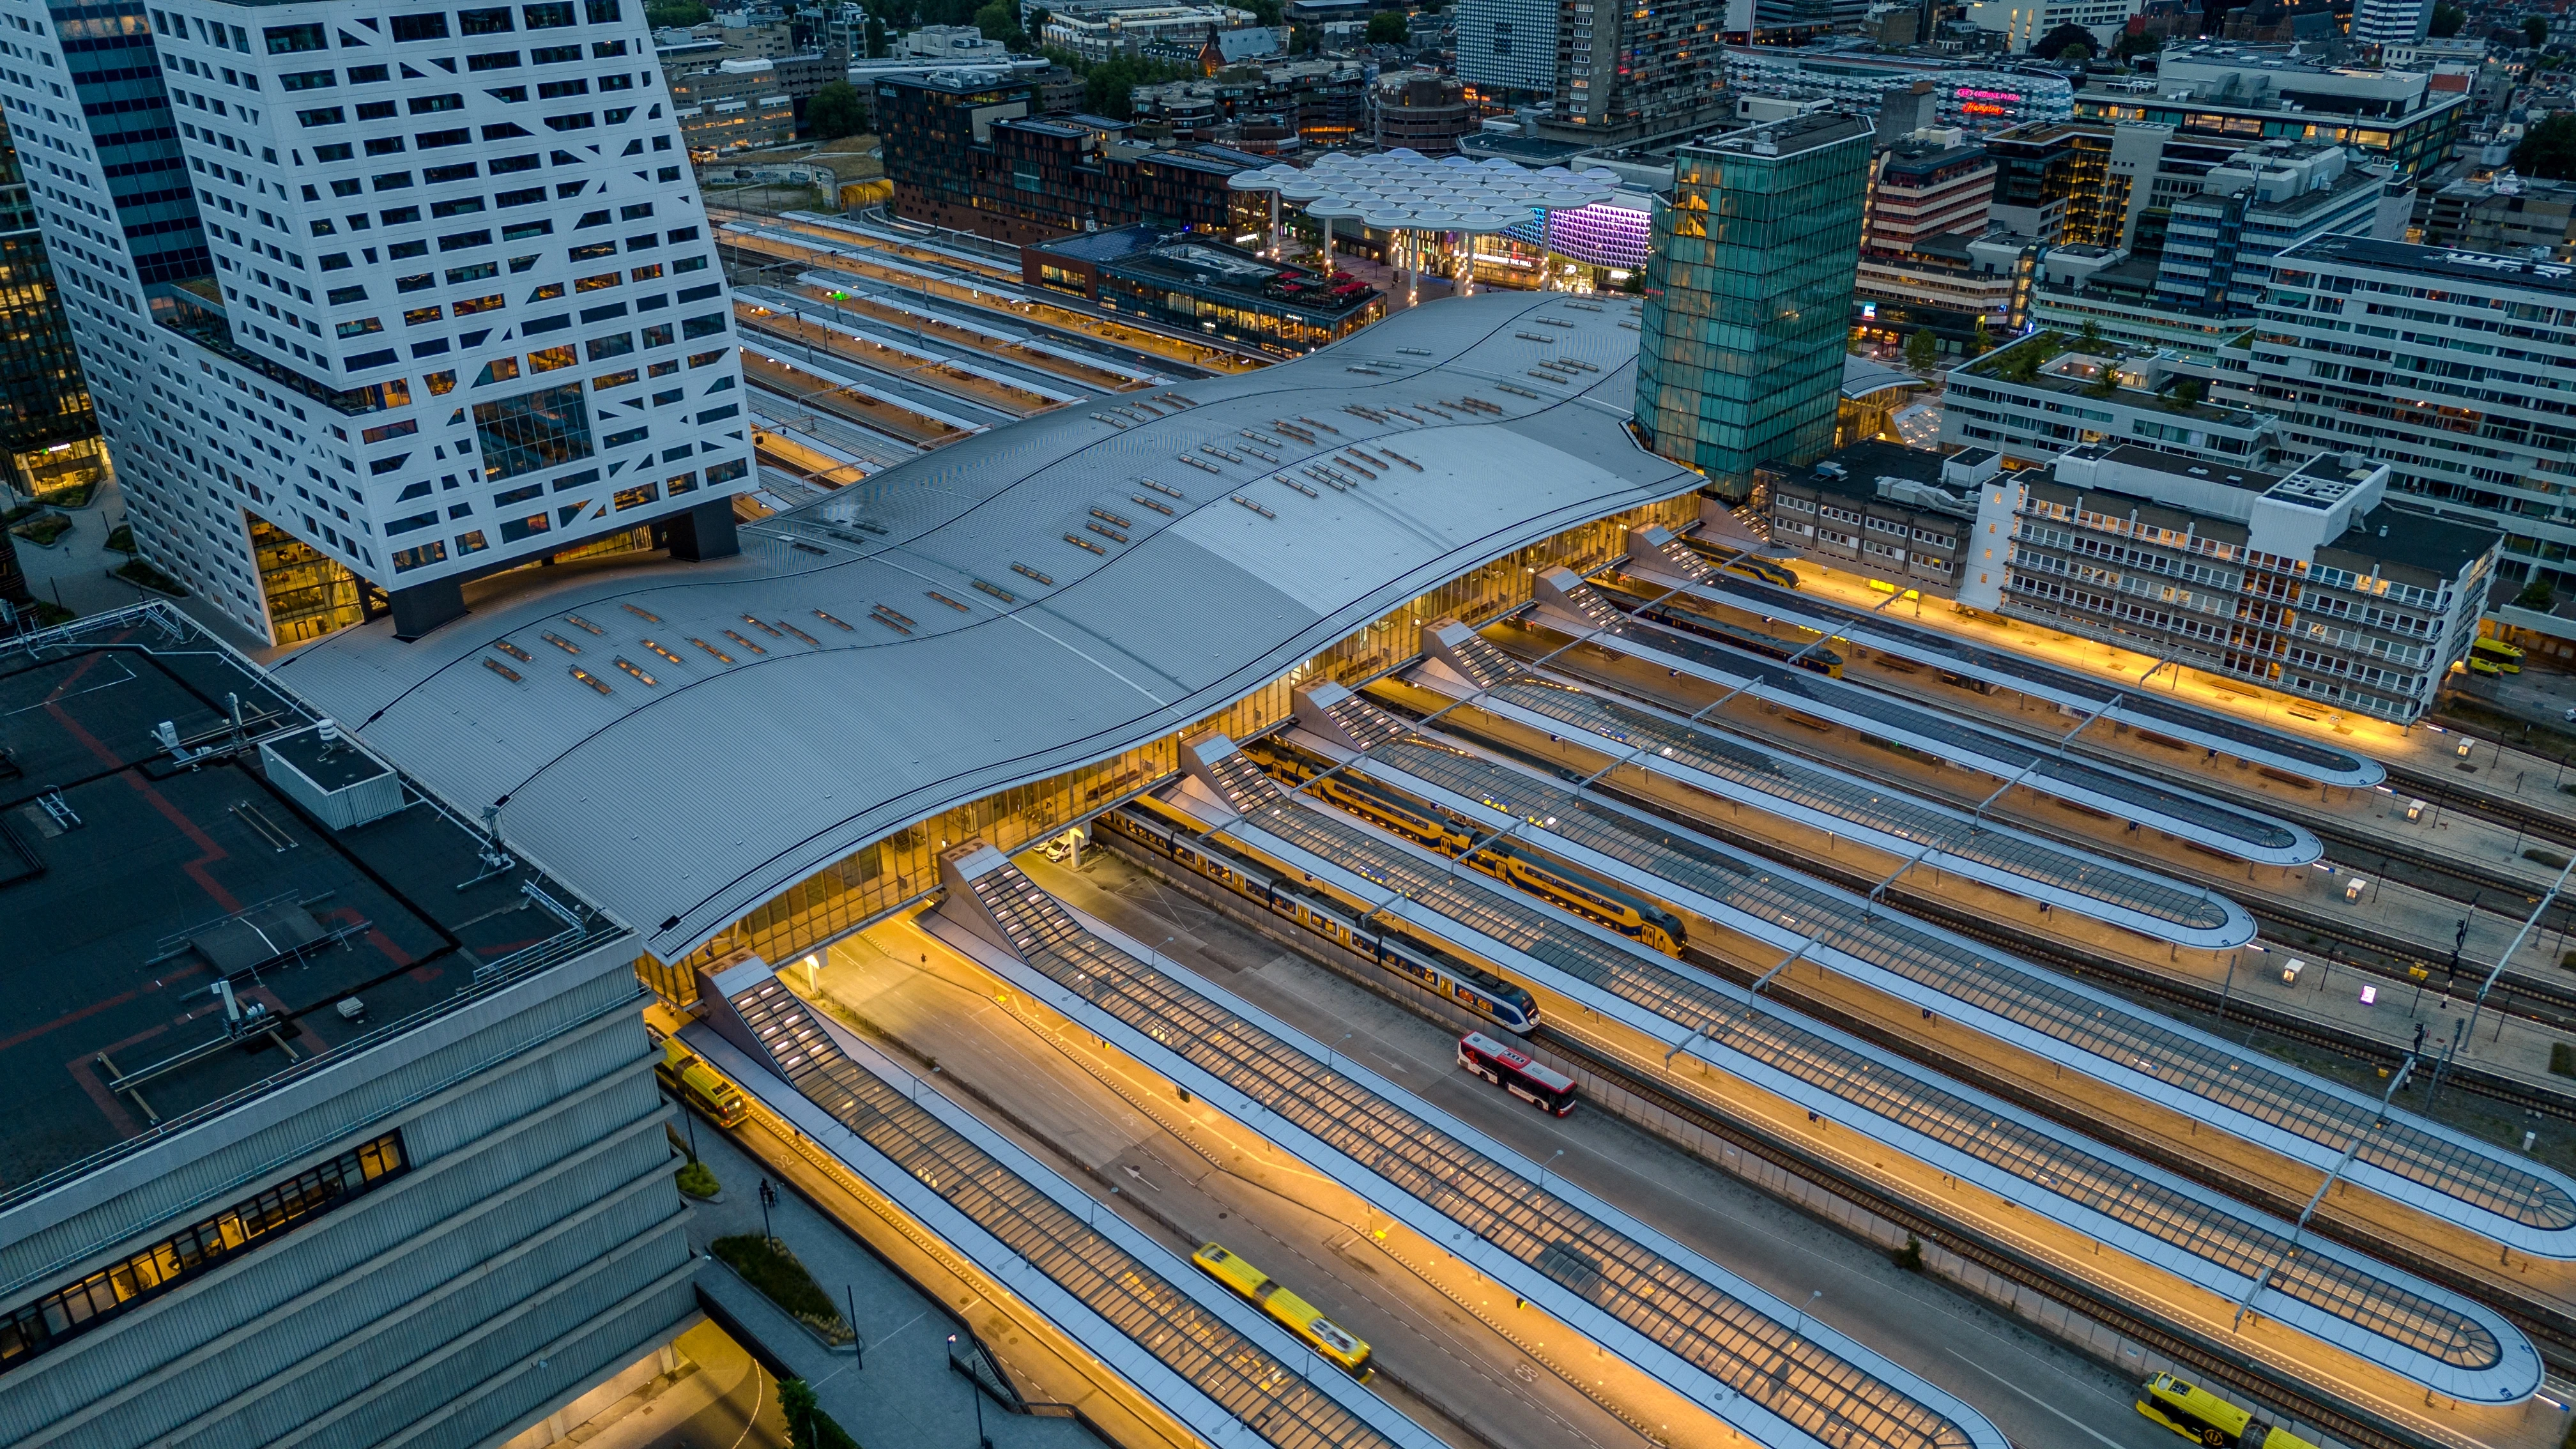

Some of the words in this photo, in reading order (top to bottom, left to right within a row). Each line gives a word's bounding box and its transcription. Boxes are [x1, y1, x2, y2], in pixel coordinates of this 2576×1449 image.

[1974, 91, 1999, 99] CROWNE
[2000, 93, 2020, 101] PLAZA
[1963, 102, 2004, 114] Hampton
[1514, 1364, 1539, 1382] C8
